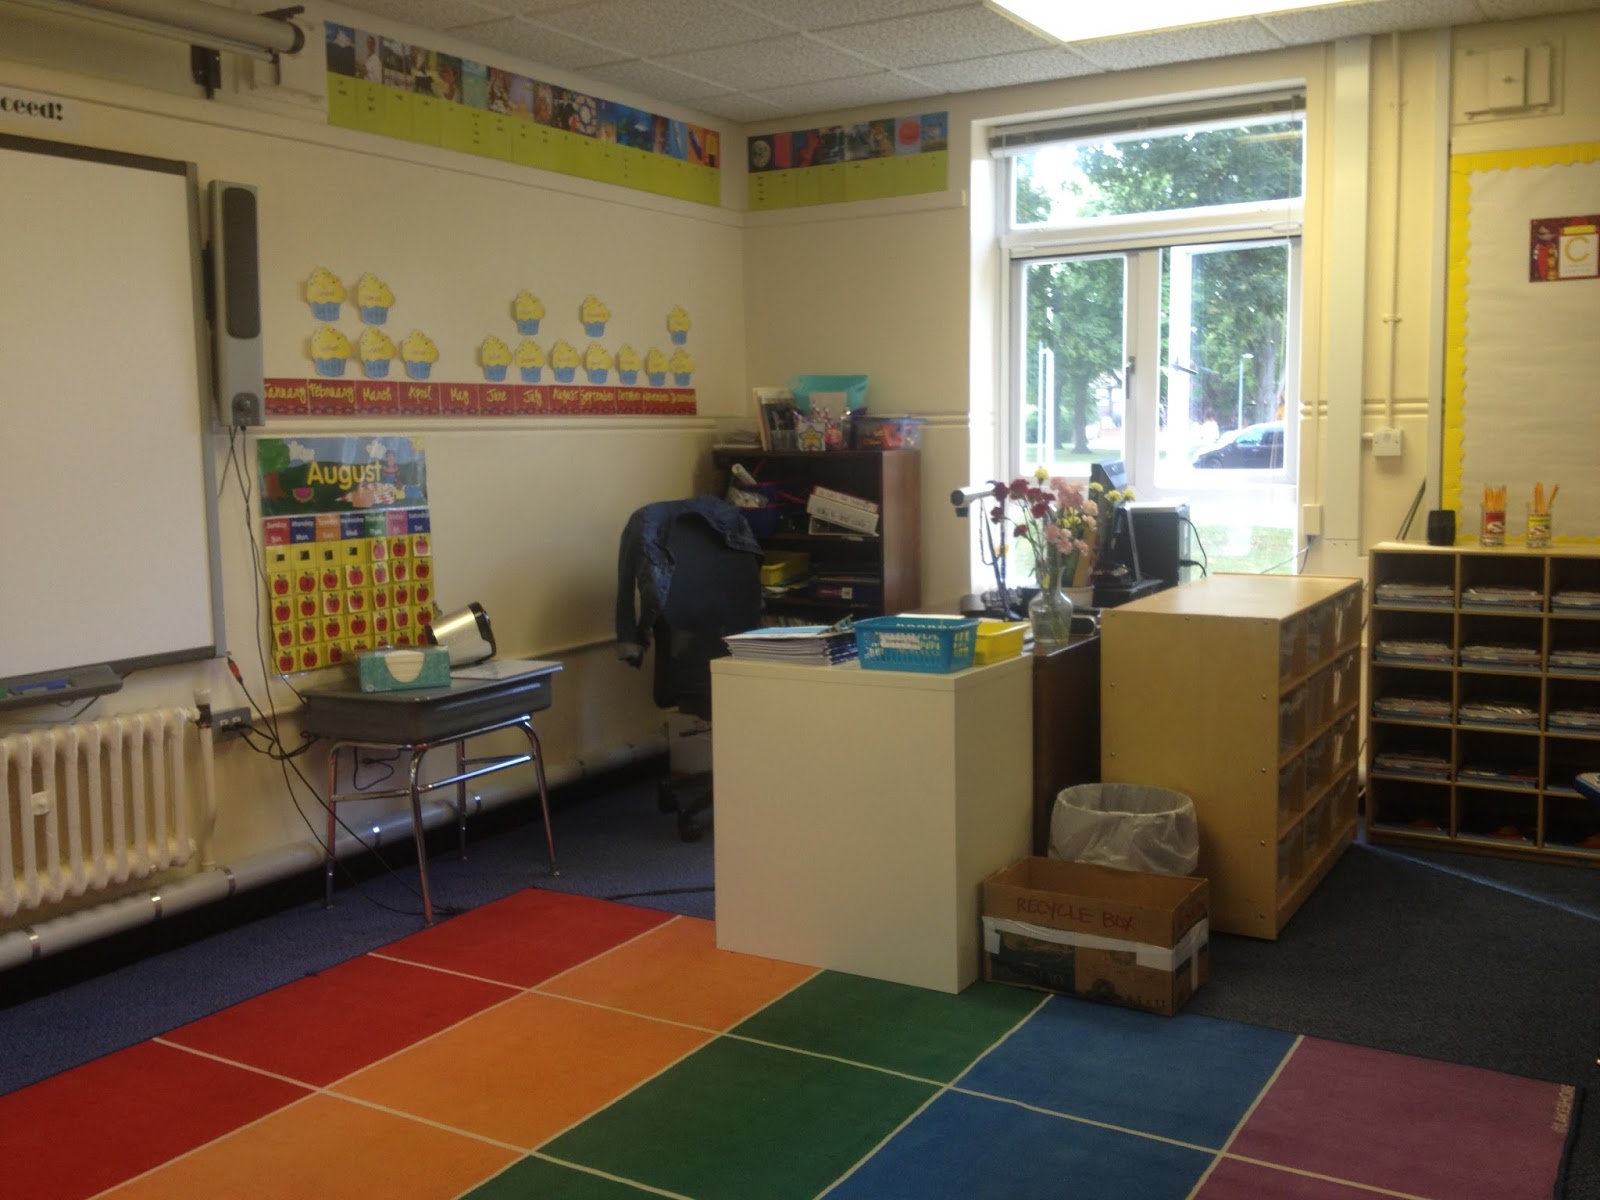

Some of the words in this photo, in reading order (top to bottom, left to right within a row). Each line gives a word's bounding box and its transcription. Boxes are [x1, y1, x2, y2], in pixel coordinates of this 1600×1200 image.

[1564, 236, 1590, 262] C
[306, 460, 382, 490] August
[1016, 897, 1095, 924] RECYCLE
[1102, 911, 1135, 932] BOX
